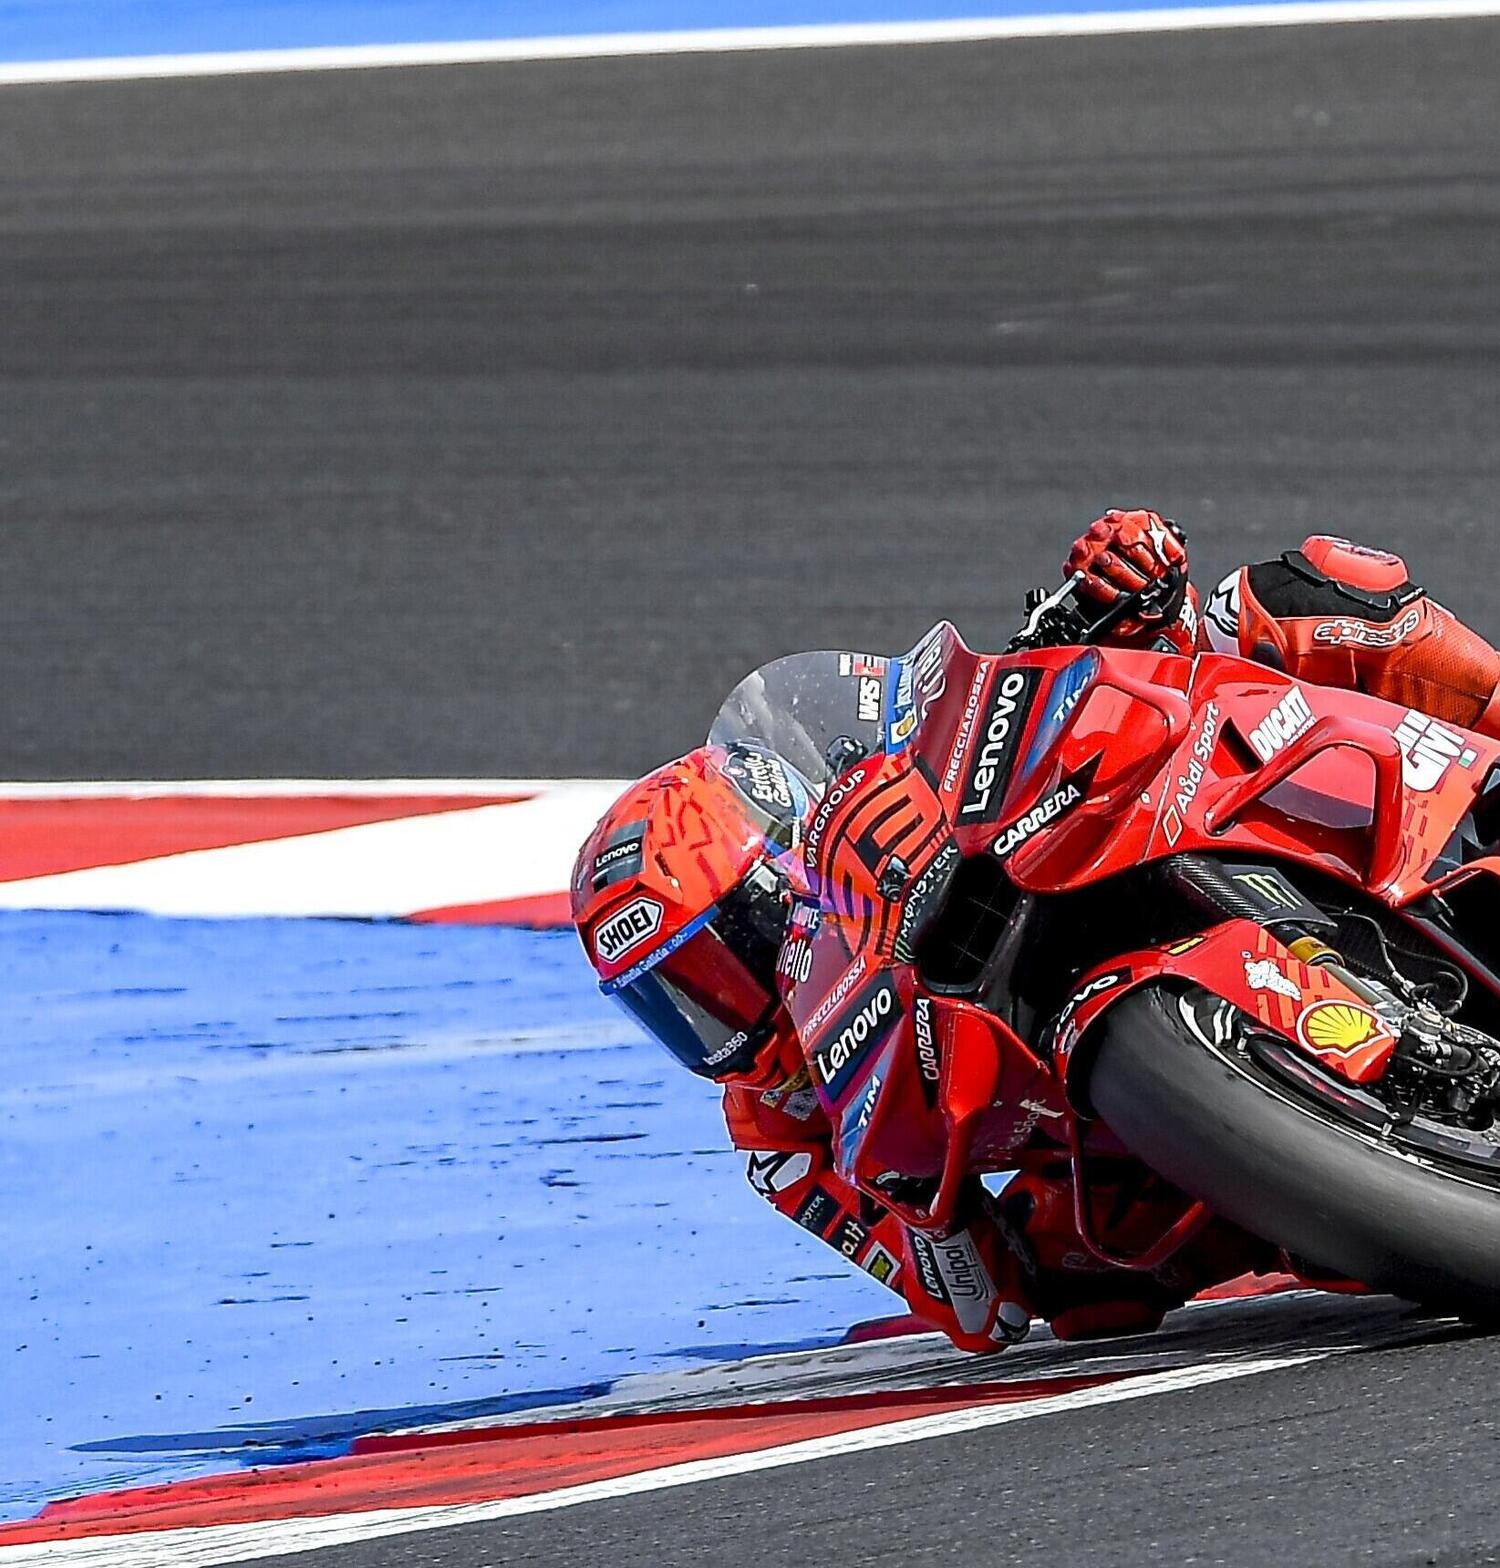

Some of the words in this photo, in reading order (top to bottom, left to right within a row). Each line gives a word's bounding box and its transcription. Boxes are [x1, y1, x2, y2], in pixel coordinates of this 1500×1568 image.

[944, 662, 991, 793] FRECCIAROSSA
[963, 673, 1024, 814] Lenovo
[1195, 703, 1221, 764] Sport
[1248, 685, 1315, 762] DUCATI
[596, 842, 641, 868] Lenovo
[993, 784, 1081, 856] CARRERA
[901, 845, 958, 939] MONSTER
[599, 906, 653, 956] SHOEI
[818, 987, 893, 1084] Lenovo
[913, 998, 940, 1080] CARRERA
[856, 1074, 882, 1130] TIM
[914, 1235, 944, 1298] Lenovo
[935, 1244, 979, 1297] Unipol
